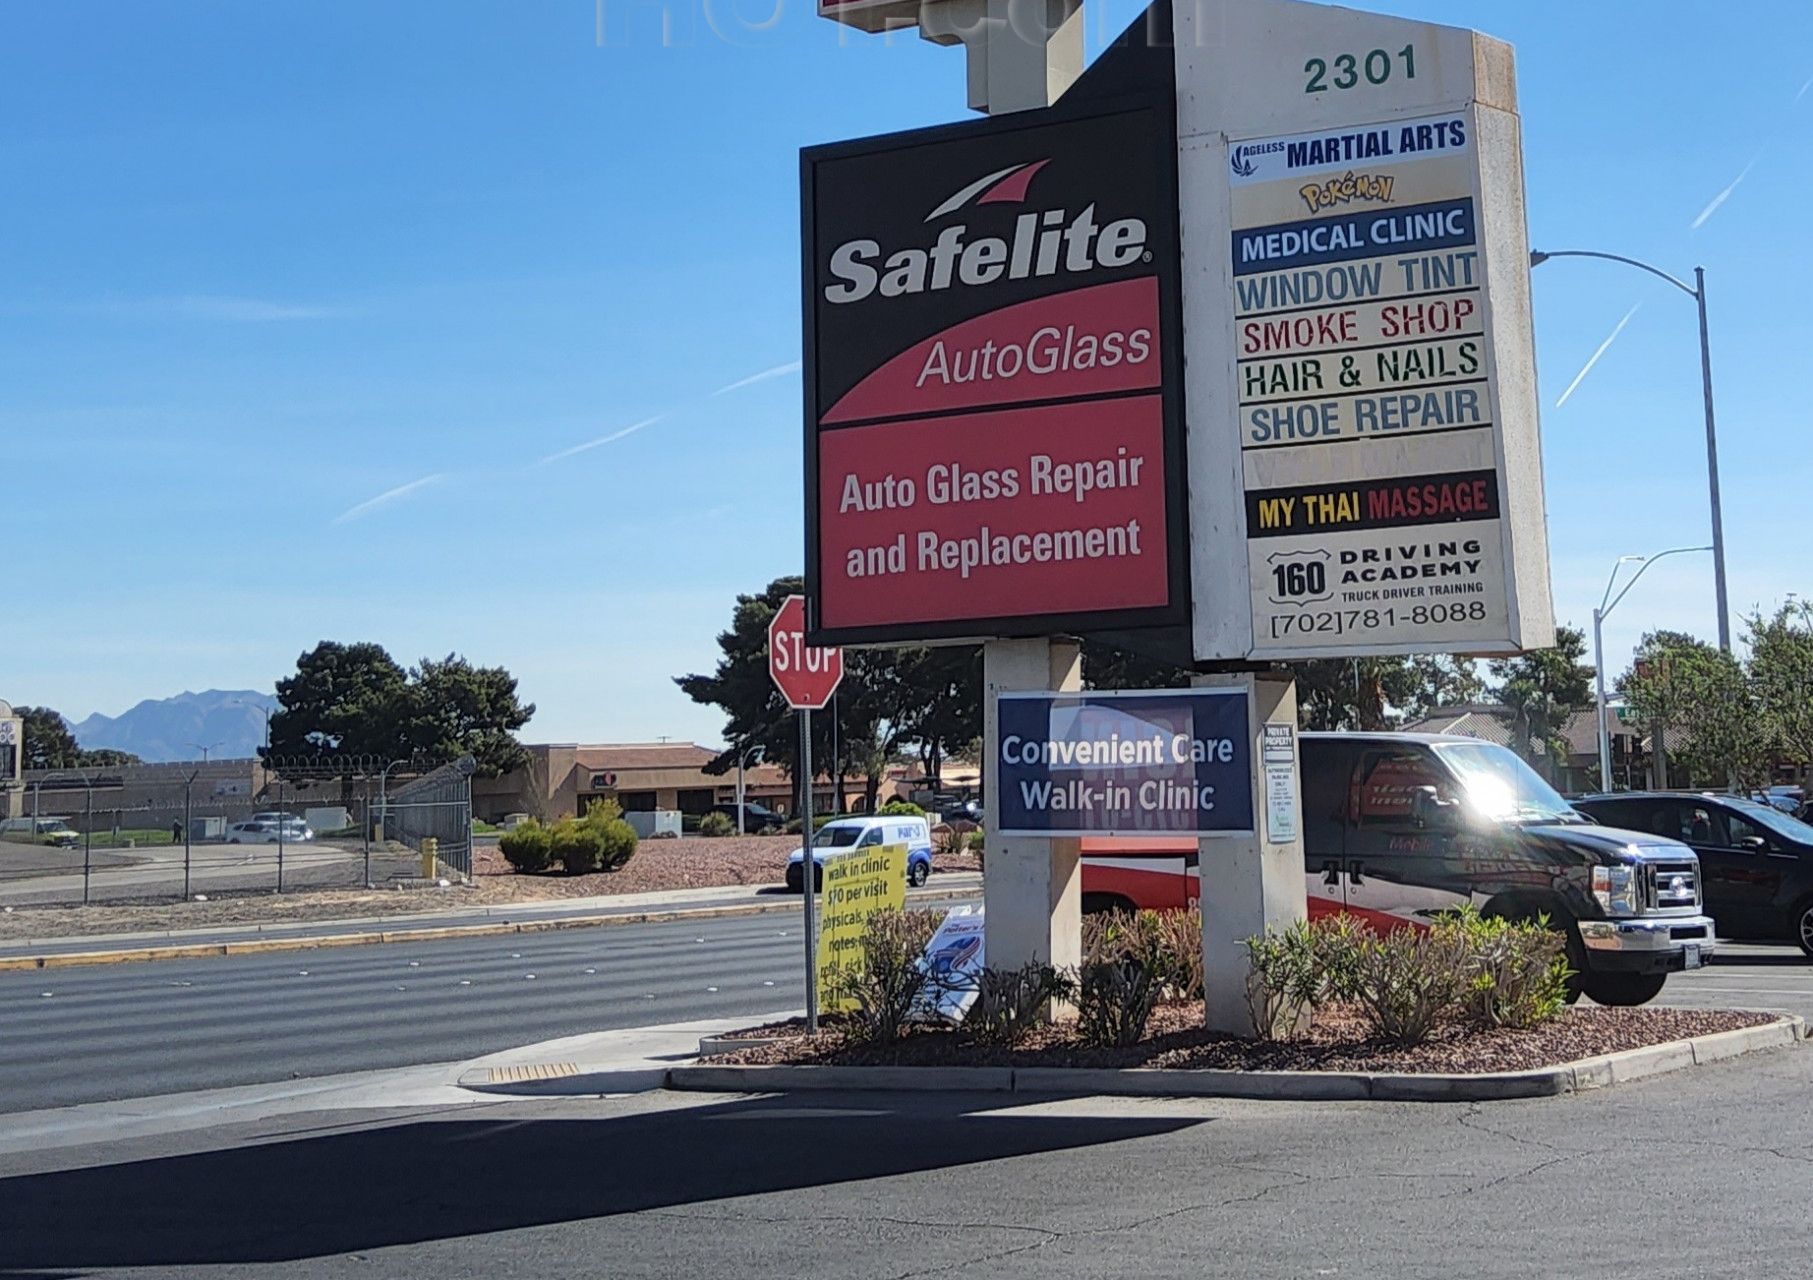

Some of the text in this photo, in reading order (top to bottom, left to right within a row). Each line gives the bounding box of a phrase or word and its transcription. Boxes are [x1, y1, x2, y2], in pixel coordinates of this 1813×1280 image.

[1304, 44, 1417, 94] 2301
[1243, 120, 1465, 168] AGELESS MARTIAL ARTS
[825, 202, 1146, 304] Safelite
[1241, 209, 1465, 262] MEDICAL CLINIC
[1237, 252, 1477, 312] WINDOW TINT
[1244, 299, 1474, 354] SMOKE SHOP
[915, 326, 1151, 388] AutoGlass
[1245, 342, 1478, 397] HAIR & NAILS
[1251, 389, 1480, 442] SHOE REPAIR
[840, 447, 1143, 513] Auto Glass Repair
[1258, 480, 1488, 529] MY THAI MASSAGE
[847, 519, 1141, 577] and Replacement
[1340, 540, 1481, 564] DRIVING
[1341, 559, 1482, 584] ACADEMY
[1272, 561, 1326, 596] 160
[1342, 581, 1483, 602] TRUCK DRIVER TRAINING
[1270, 601, 1486, 638] [702]781-8088
[1002, 734, 1233, 764] Convenient Care
[1020, 780, 1215, 810] Walk-in Clinic
[828, 856, 890, 882] walk in clinic
[846, 888, 862, 905] per
[864, 880, 888, 898] visit
